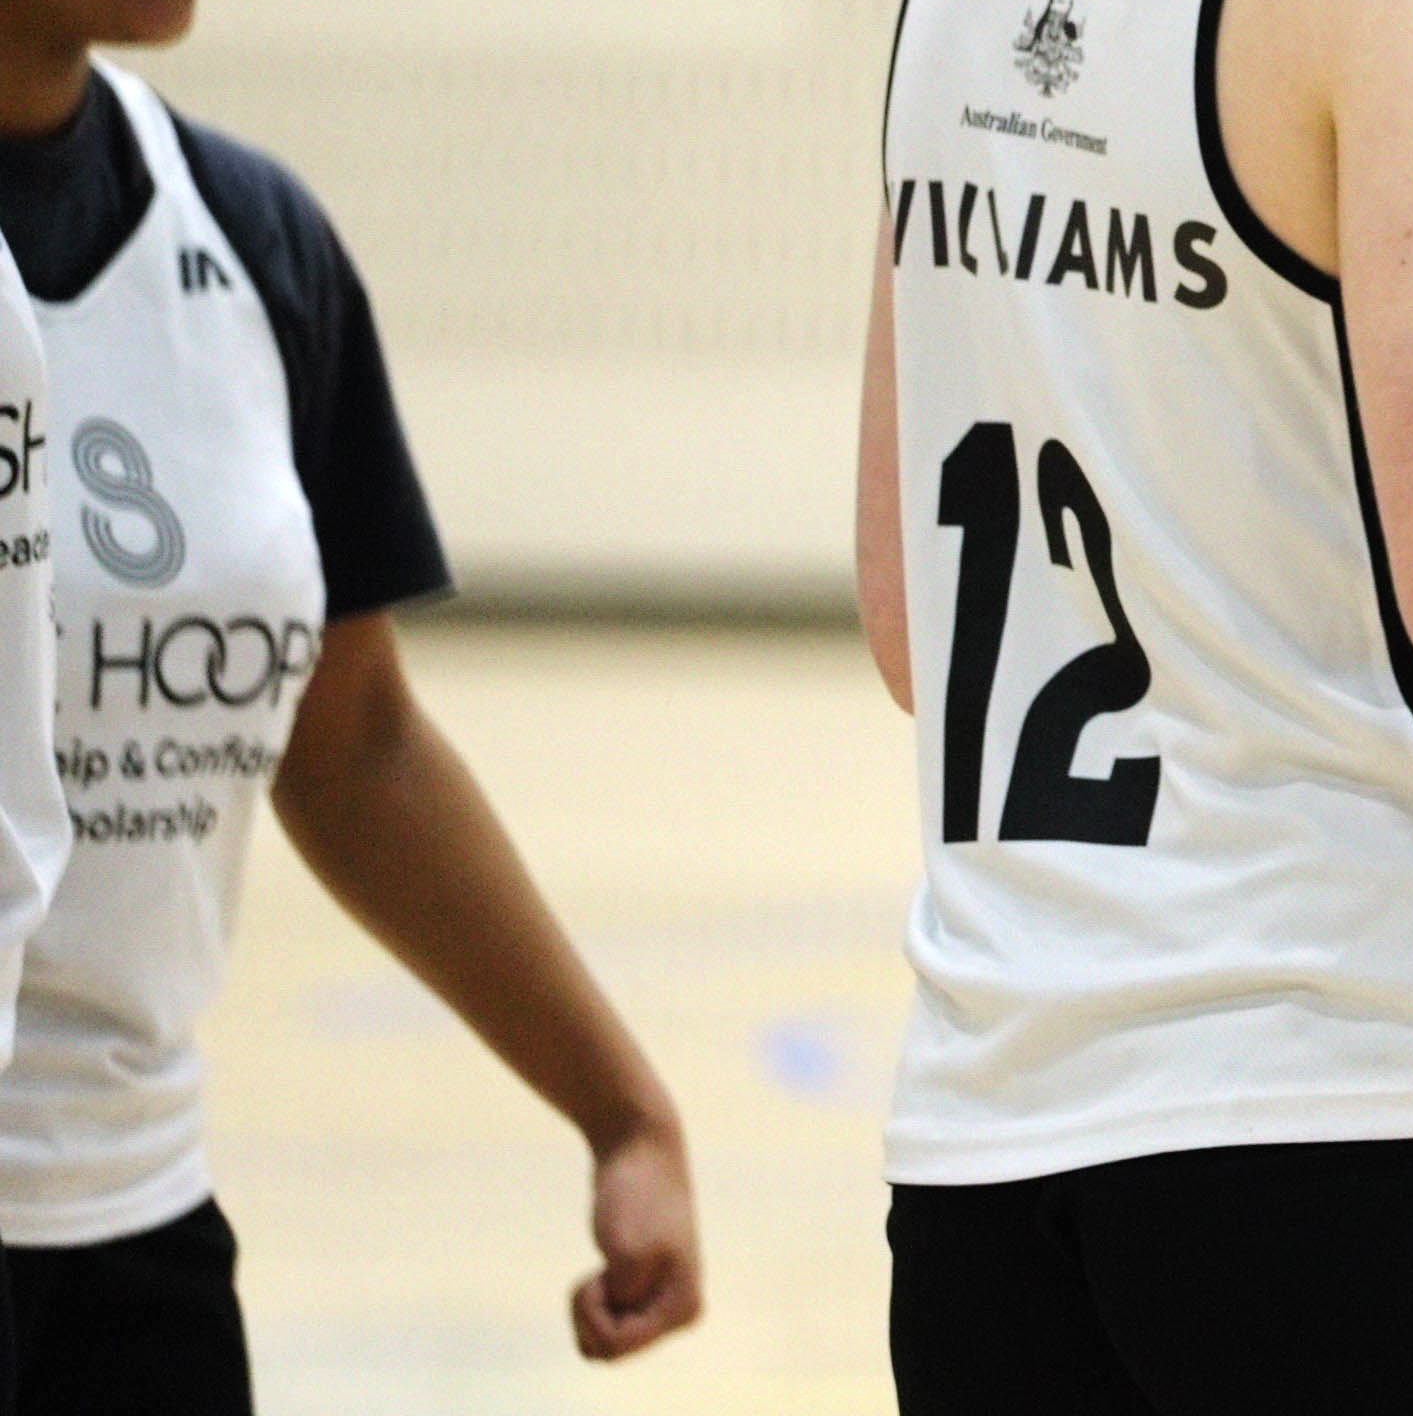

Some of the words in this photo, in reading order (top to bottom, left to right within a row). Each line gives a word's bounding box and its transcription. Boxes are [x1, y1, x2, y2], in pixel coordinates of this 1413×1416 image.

[960, 102, 1038, 140] Australian
[1040, 117, 1108, 156] Government
[89, 616, 313, 710] HOOP
[937, 421, 1161, 847] 12
